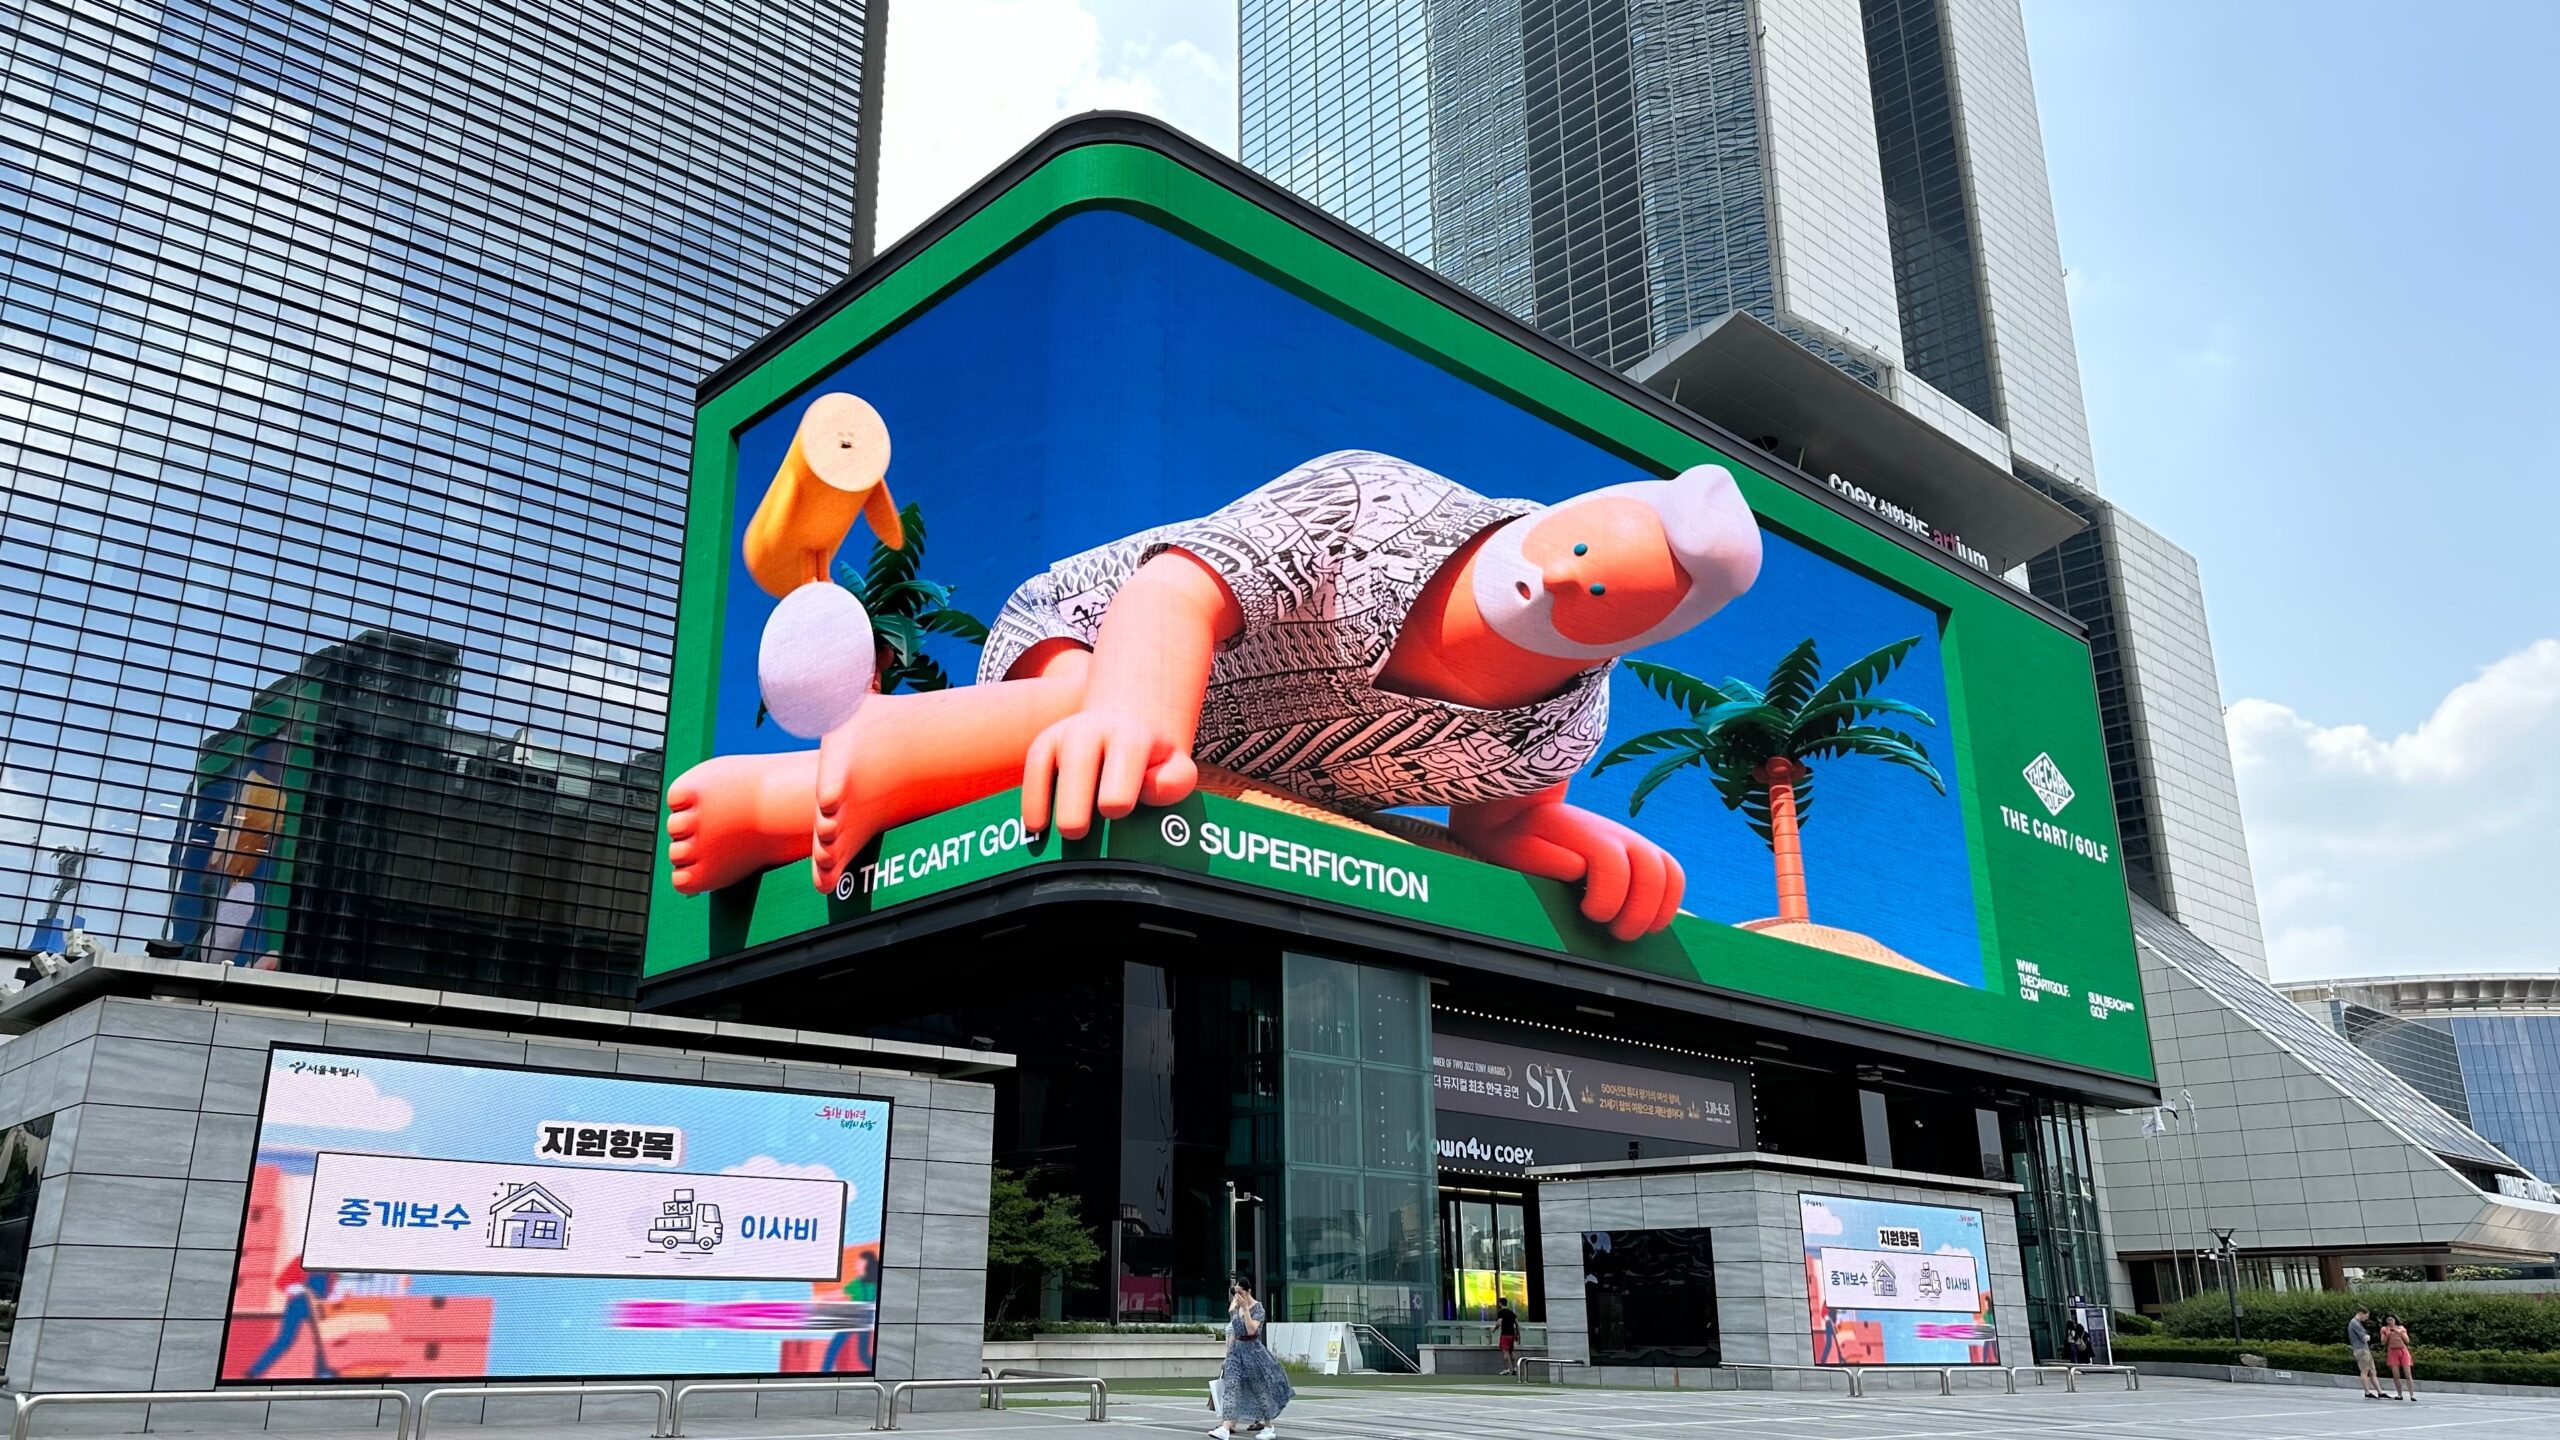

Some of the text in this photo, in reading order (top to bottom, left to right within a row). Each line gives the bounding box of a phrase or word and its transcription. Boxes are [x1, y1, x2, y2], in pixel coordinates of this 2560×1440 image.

[2000, 805, 2030, 835] THE
[860, 854, 905, 894] THE
[908, 831, 976, 879] CART
[979, 816, 1040, 857] GOL
[1199, 822, 1429, 903] SUPERFICTION
[2020, 986, 2039, 1002] COM
[2090, 1005, 2108, 1020] GOLF
[306, 1064, 360, 1079] 서울특별시
[1442, 1076, 1468, 1093] 뮤지컬
[1468, 1079, 1486, 1094] 최초
[1486, 1081, 1502, 1097] 한국
[1503, 1084, 1520, 1100] 공연
[542, 1125, 675, 1161] 지원항목
[1495, 1145, 1533, 1165] coex
[337, 1198, 817, 1242] 중개보수 이사비
[1879, 1229, 1920, 1248] 지원항목
[1831, 1270, 1971, 1291] 중개보수 이사비
